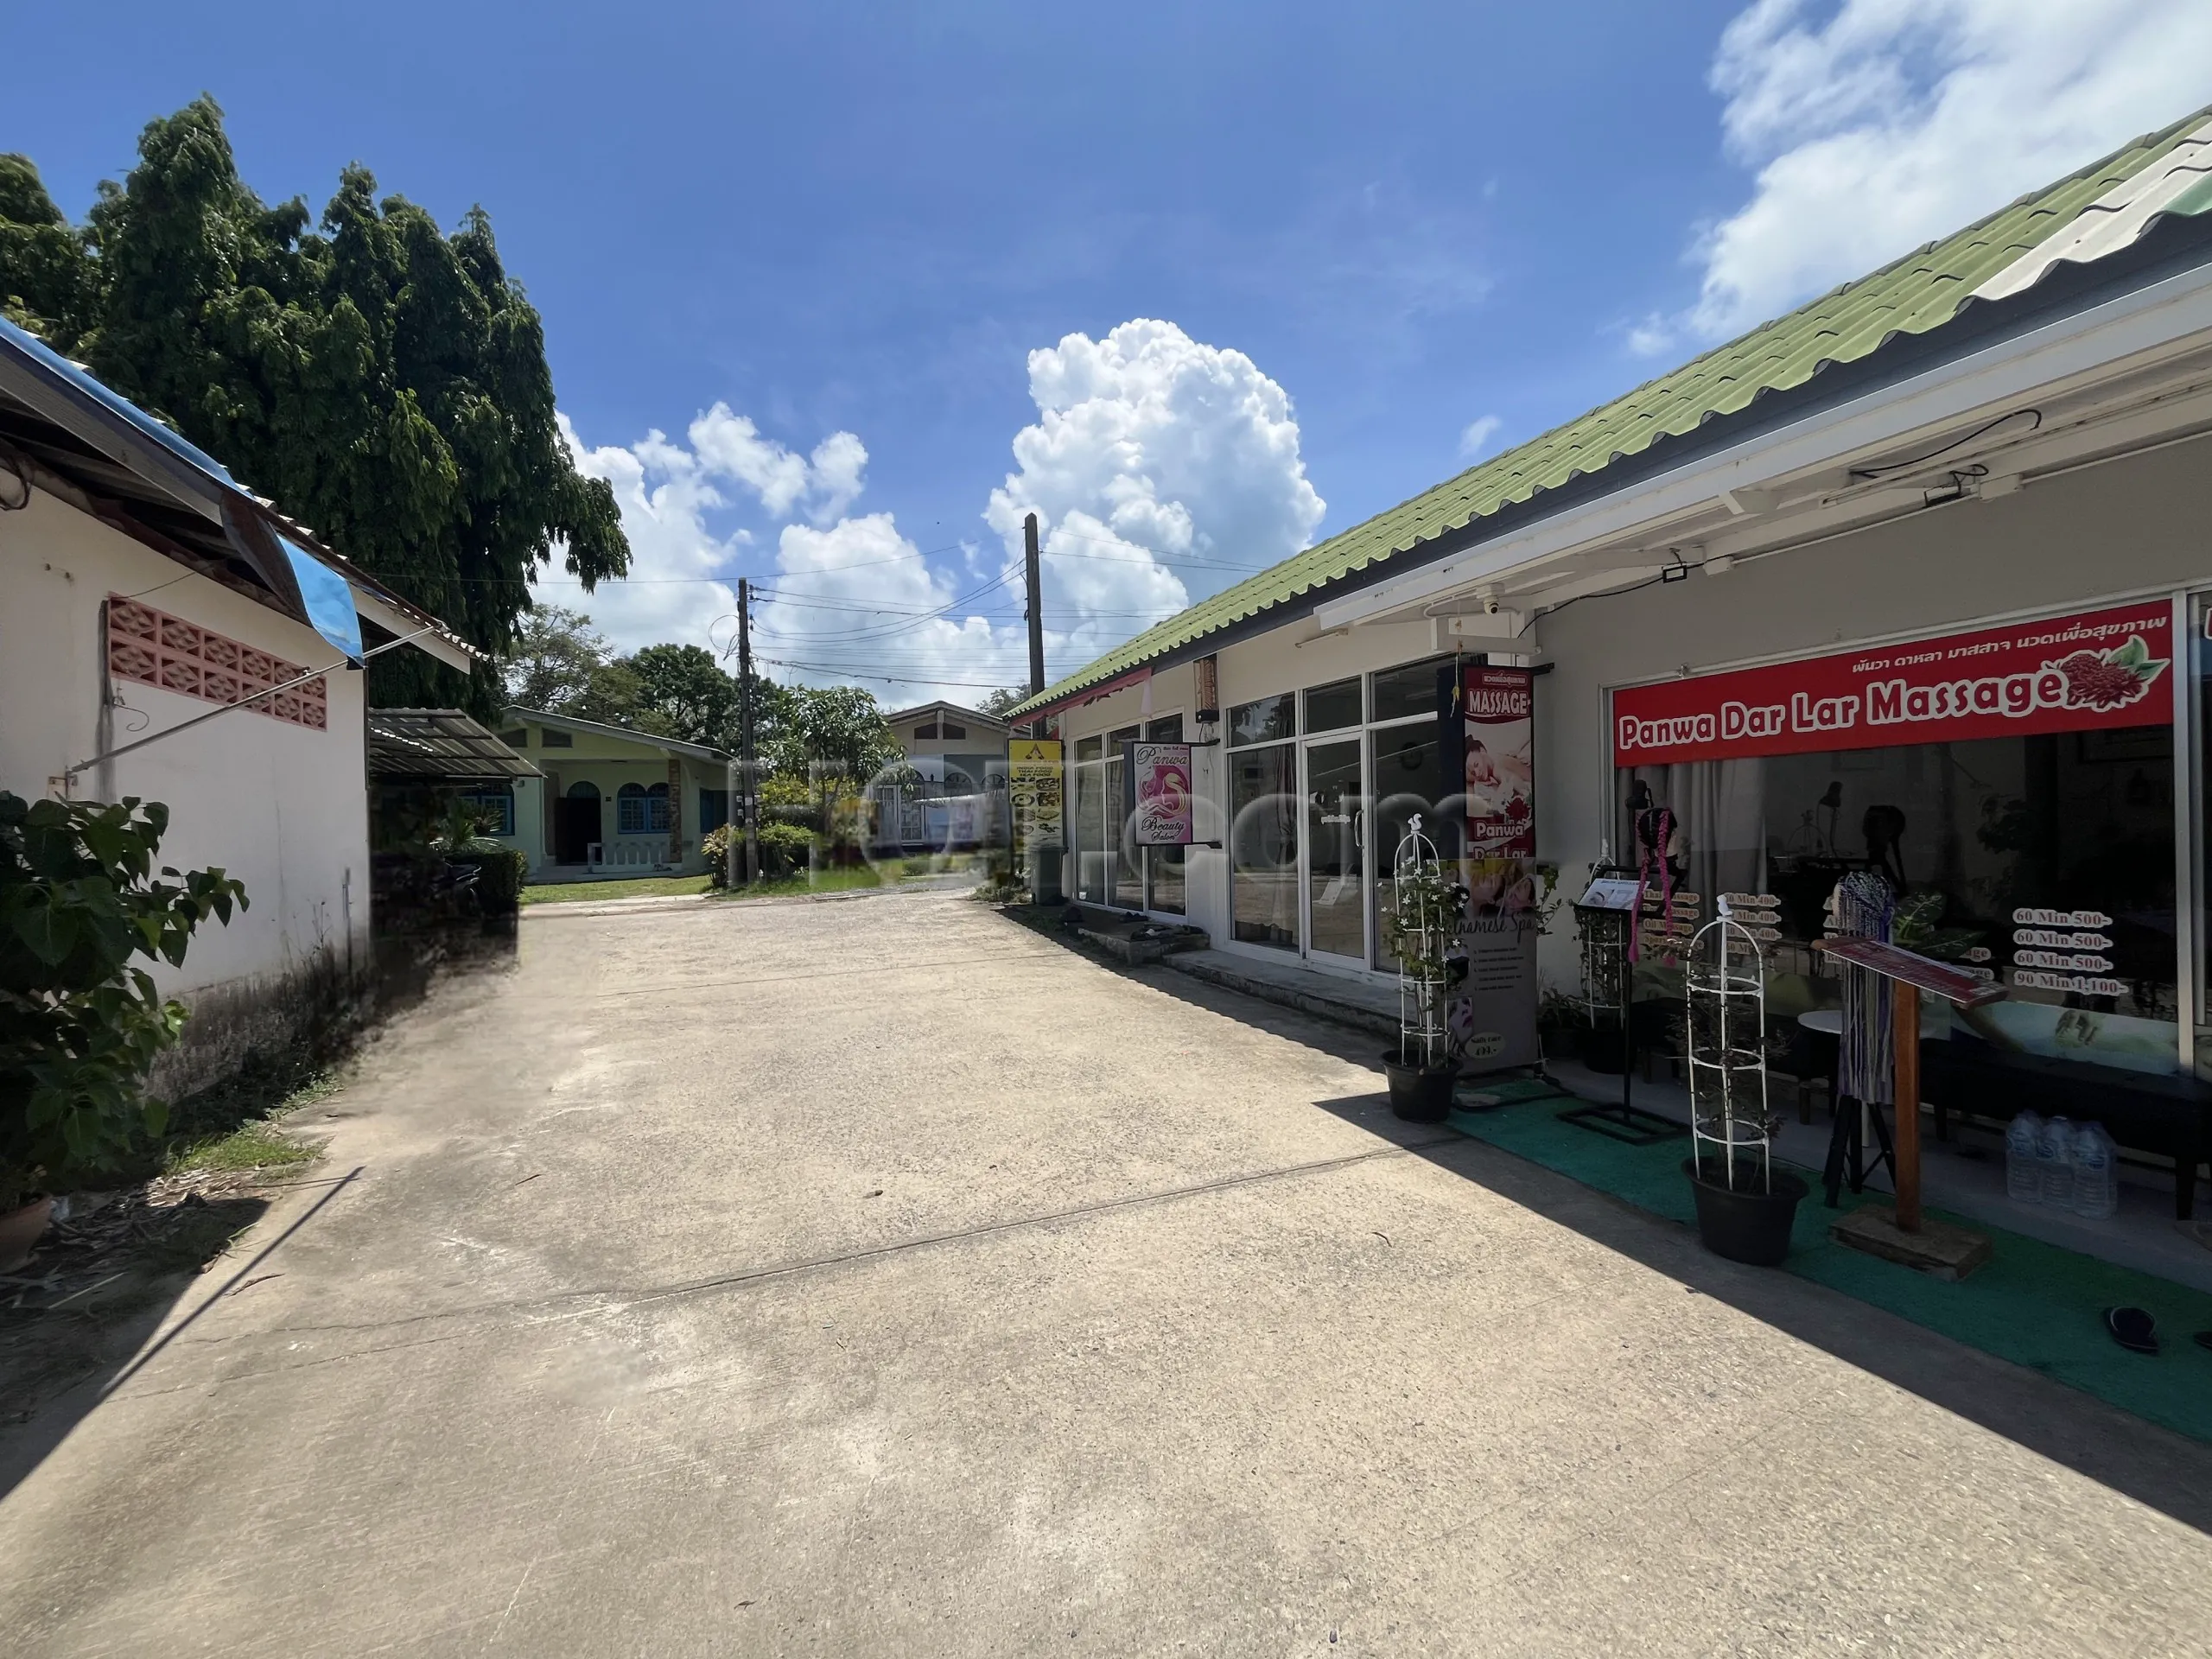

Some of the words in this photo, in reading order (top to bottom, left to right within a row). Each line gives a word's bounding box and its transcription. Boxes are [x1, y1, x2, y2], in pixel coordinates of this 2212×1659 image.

[2016, 615, 2167, 649] นวดเพื่อสุขภาพ
[1468, 690, 1529, 715] MASSAGE
[1619, 713, 1715, 750] Panwa
[1721, 701, 1785, 740] Dar
[1792, 693, 1859, 734] Lar
[1866, 664, 2070, 724] Massage
[1136, 746, 1189, 766] Panwa
[1141, 816, 1185, 837] Beauty
[1474, 821, 1524, 838] Panwa
[2016, 910, 2032, 921] 60
[2038, 912, 2069, 924] Min
[1510, 912, 1534, 944] Spa
[2017, 931, 2033, 943] 60
[2039, 932, 2069, 945] Min
[2018, 952, 2034, 963] 60
[2040, 954, 2069, 967] Min
[2018, 973, 2034, 984] 90
[2040, 975, 2070, 988] Min
